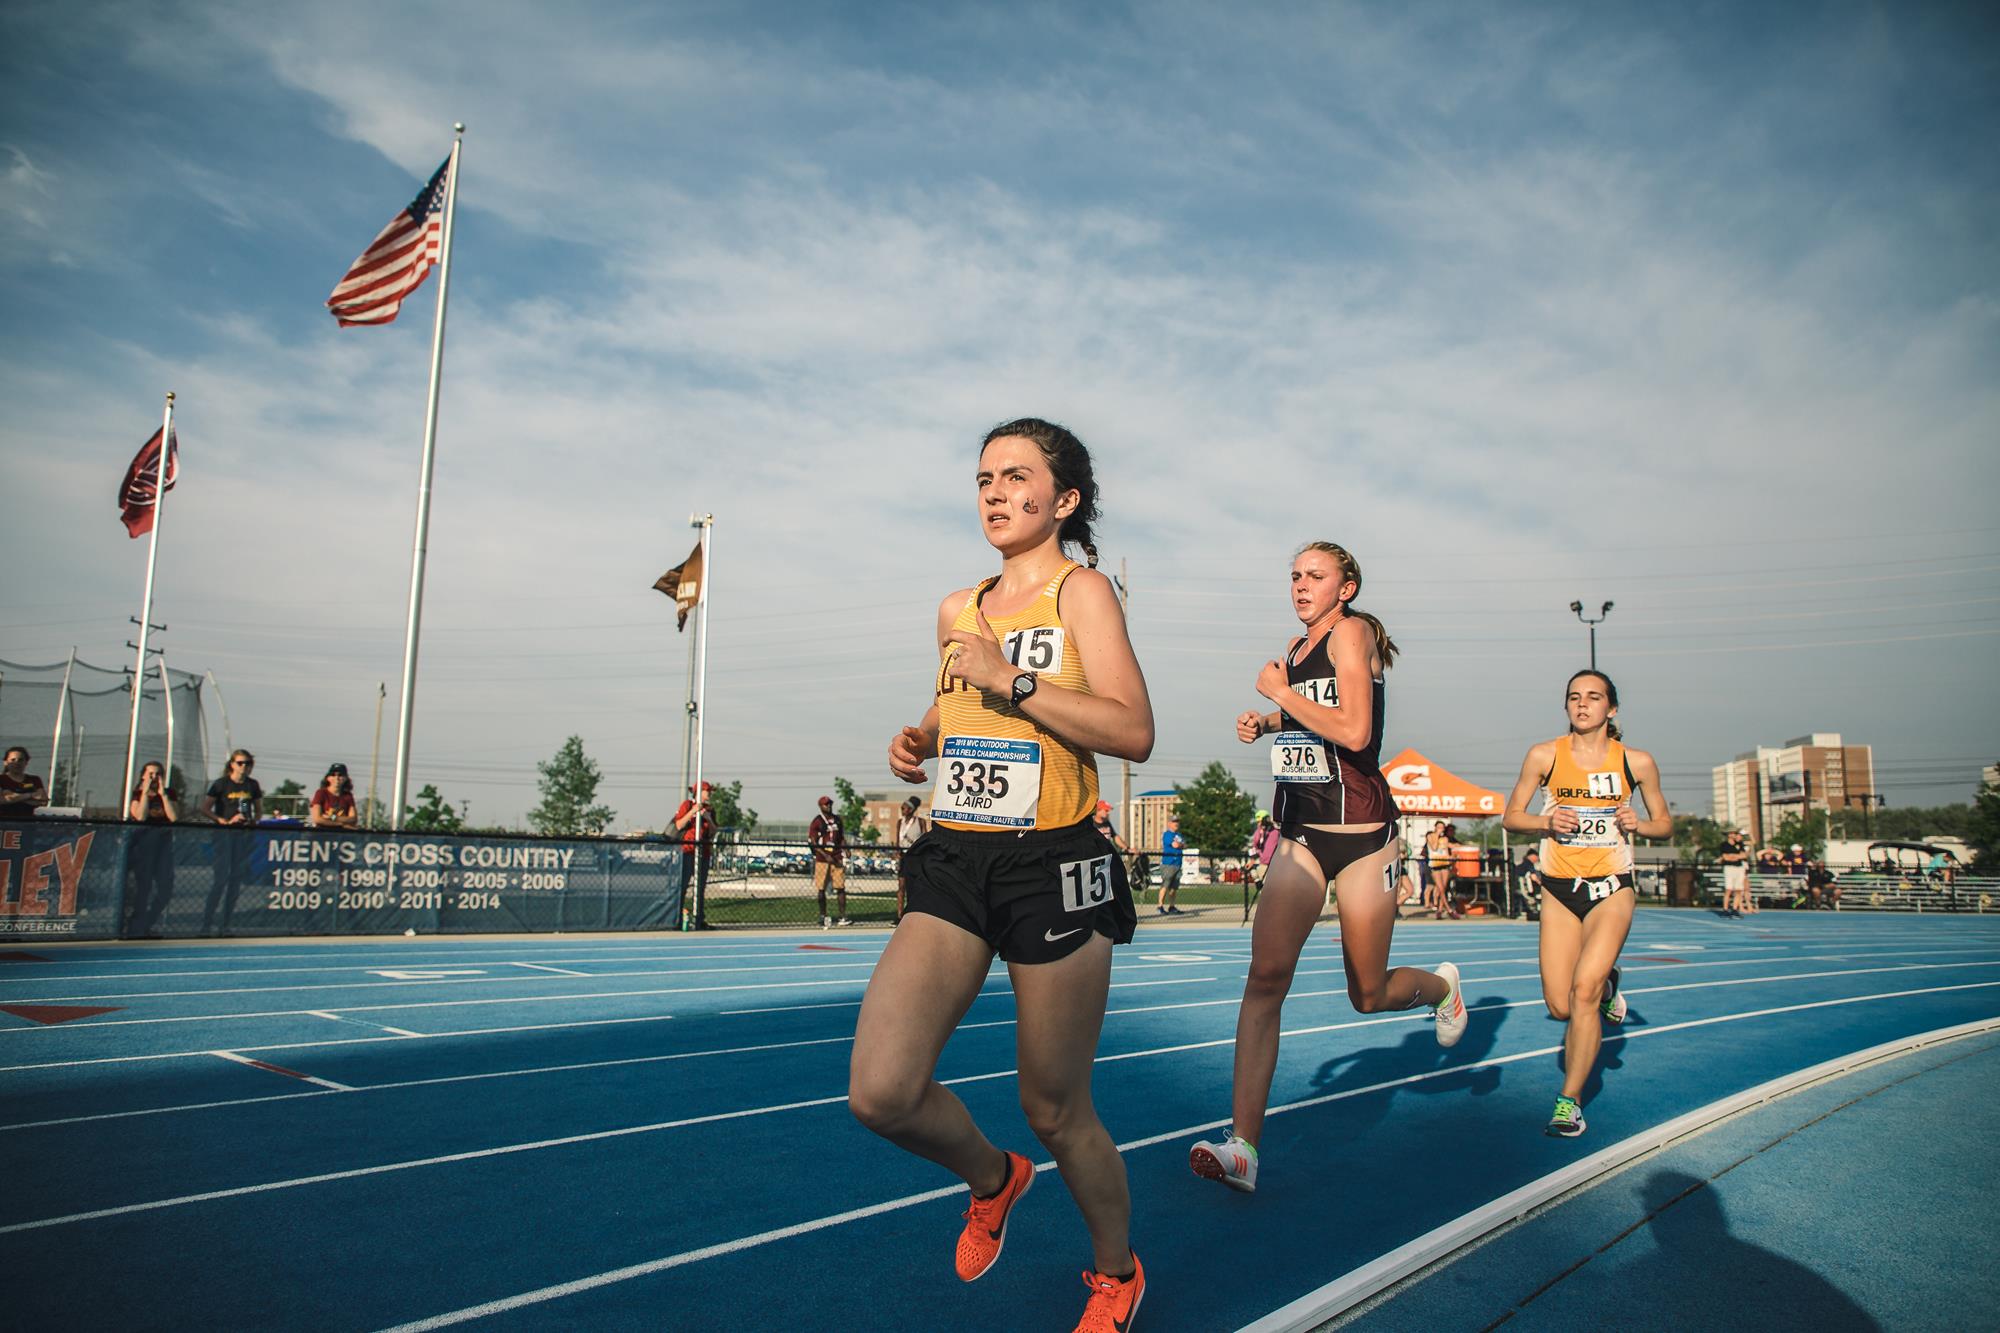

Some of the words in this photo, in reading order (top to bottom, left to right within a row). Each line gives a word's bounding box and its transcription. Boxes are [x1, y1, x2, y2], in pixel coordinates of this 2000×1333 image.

[1008, 629, 1054, 670] 15
[1309, 679, 1340, 705] 14
[966, 739, 979, 748] MVC
[980, 740, 1010, 750] OUTDOOR
[977, 749, 1031, 761] CHAMPIONSHIPS
[1282, 747, 1316, 766] 376
[1281, 766, 1319, 774] BUSCHLING
[947, 761, 1009, 799] 335
[955, 795, 992, 809] LAIRD
[1392, 795, 1466, 811] TORADE
[956, 812, 968, 820] 2018
[973, 814, 992, 822] TERRE
[268, 840, 356, 863] MEN'S
[363, 842, 454, 865] CROSS
[460, 846, 575, 869] COUNTRY
[272, 869, 321, 887] 1996
[340, 869, 386, 888] 1998
[401, 870, 448, 888] 2004
[463, 871, 507, 889] 2005
[521, 873, 565, 890] 2006
[1066, 858, 1107, 907] 15
[268, 891, 321, 909] 2009
[338, 891, 384, 909] 2010
[400, 892, 443, 909] 2011
[458, 892, 501, 909] 2014
